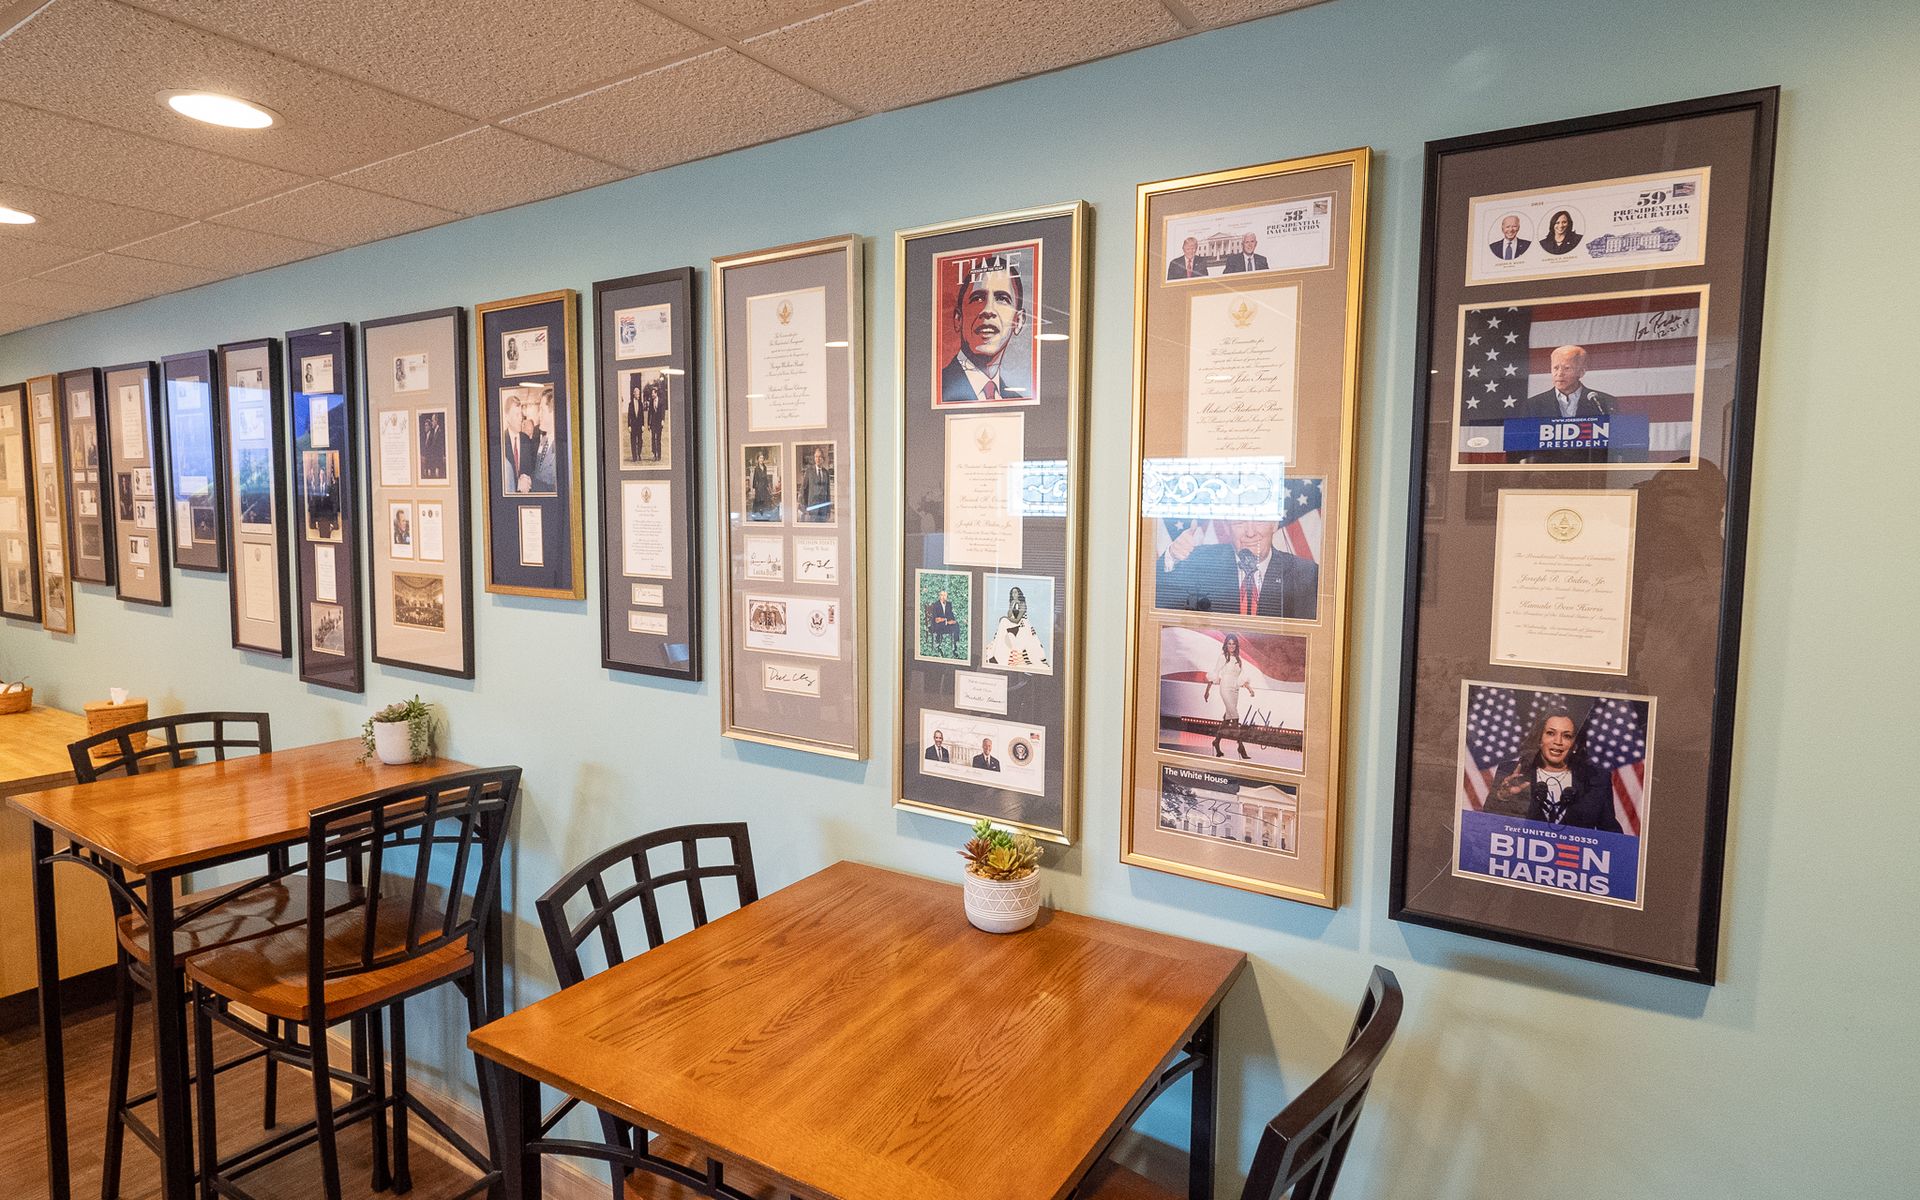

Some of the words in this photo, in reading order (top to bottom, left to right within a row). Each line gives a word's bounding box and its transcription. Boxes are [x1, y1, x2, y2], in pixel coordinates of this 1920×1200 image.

[1613, 203, 1690, 216] PRESIDENTIAL
[1613, 209, 1690, 222] INAUGURATION
[1266, 219, 1321, 231] PRESIDENTIAL
[1266, 224, 1321, 235] INAUGURATION
[952, 252, 1022, 285] TIME
[1539, 422, 1610, 441] BIDEN
[1539, 440, 1609, 448] PRESIDENT
[1164, 767, 1178, 776] The
[1180, 770, 1203, 781] White
[1204, 773, 1228, 785] House
[1504, 825, 1521, 833] Text
[1522, 828, 1557, 839] UNITED
[1568, 835, 1599, 845] 30330
[1490, 832, 1611, 874] BIDEN
[1488, 857, 1610, 896] HARRIS
